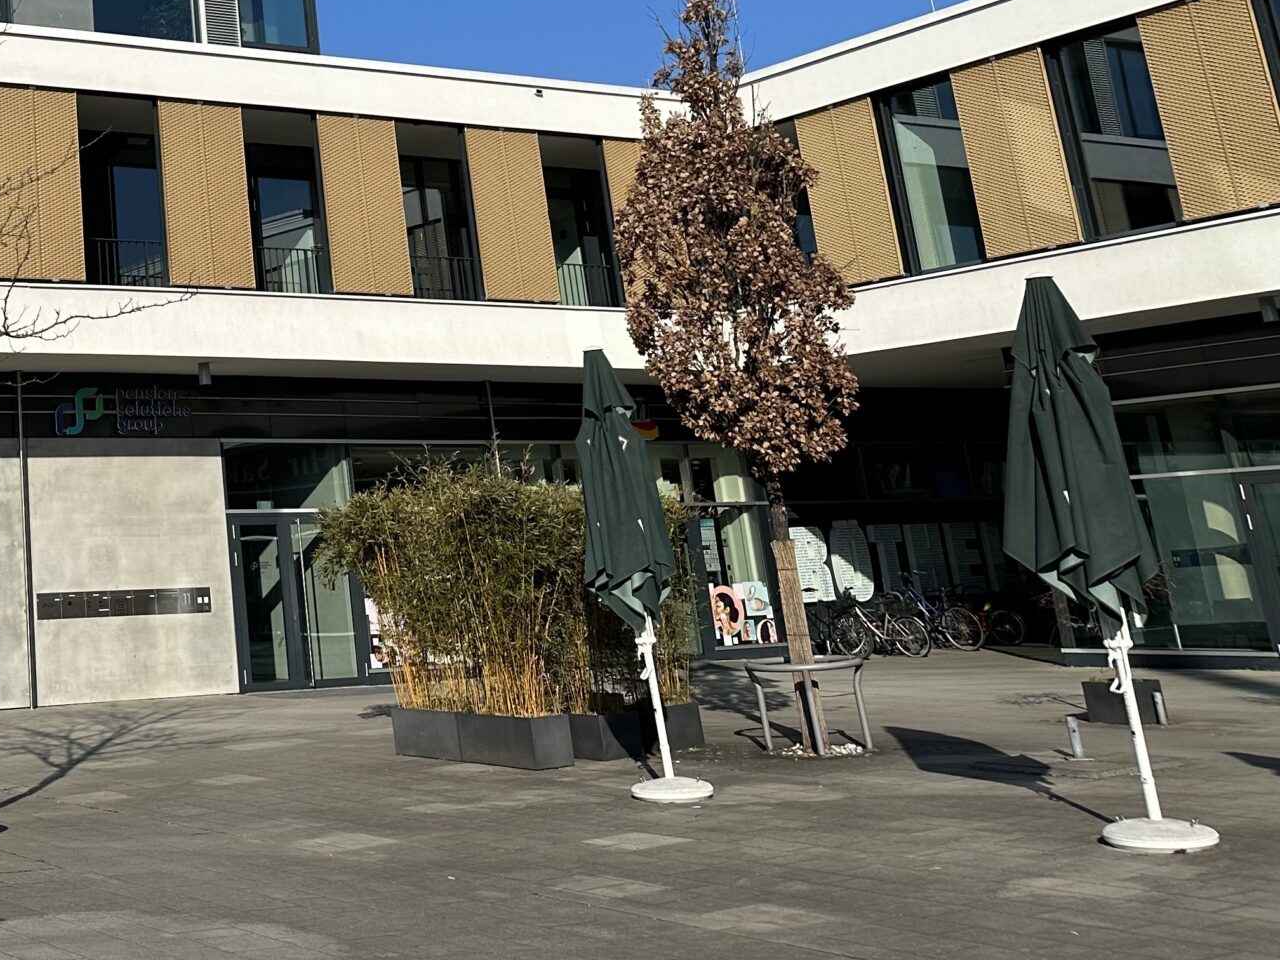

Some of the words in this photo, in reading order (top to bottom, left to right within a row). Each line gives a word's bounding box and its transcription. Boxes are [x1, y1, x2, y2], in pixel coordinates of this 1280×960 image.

[115, 385, 177, 405] pension
[115, 400, 193, 417] solutions
[115, 417, 164, 435] group
